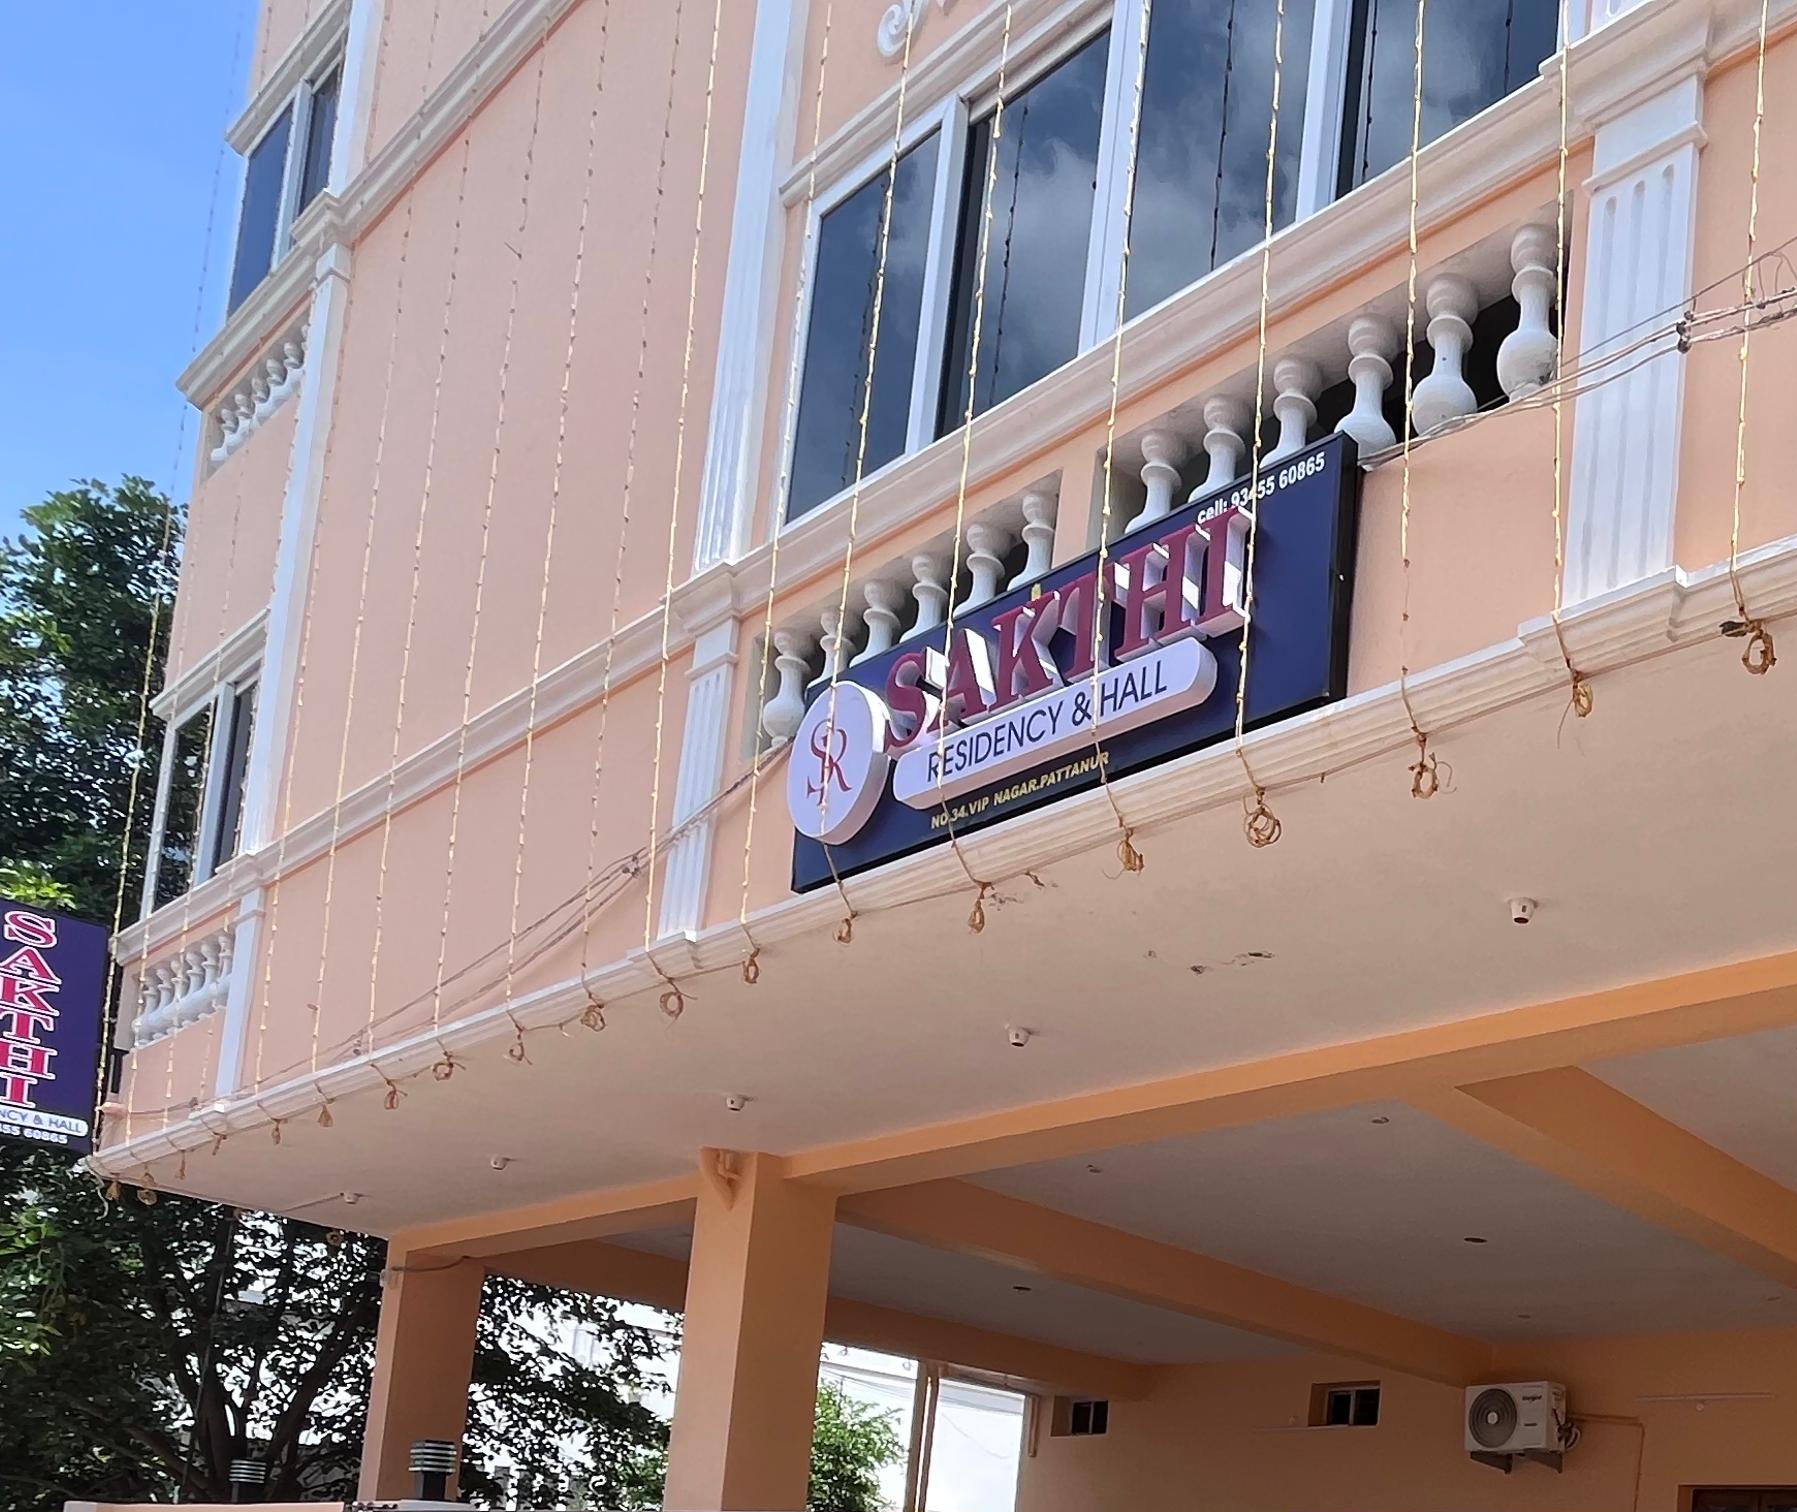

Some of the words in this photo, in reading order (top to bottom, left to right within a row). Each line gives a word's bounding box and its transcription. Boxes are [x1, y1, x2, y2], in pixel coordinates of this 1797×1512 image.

[1278, 452, 1326, 489] 60865
[885, 507, 1246, 750] SAKTHI
[927, 700, 1063, 782] RESIDENCY
[1072, 691, 1092, 727] &
[1100, 660, 1168, 717] HALL
[0, 911, 62, 1108] SAKTHI
[48, 1117, 81, 1134] HALL
